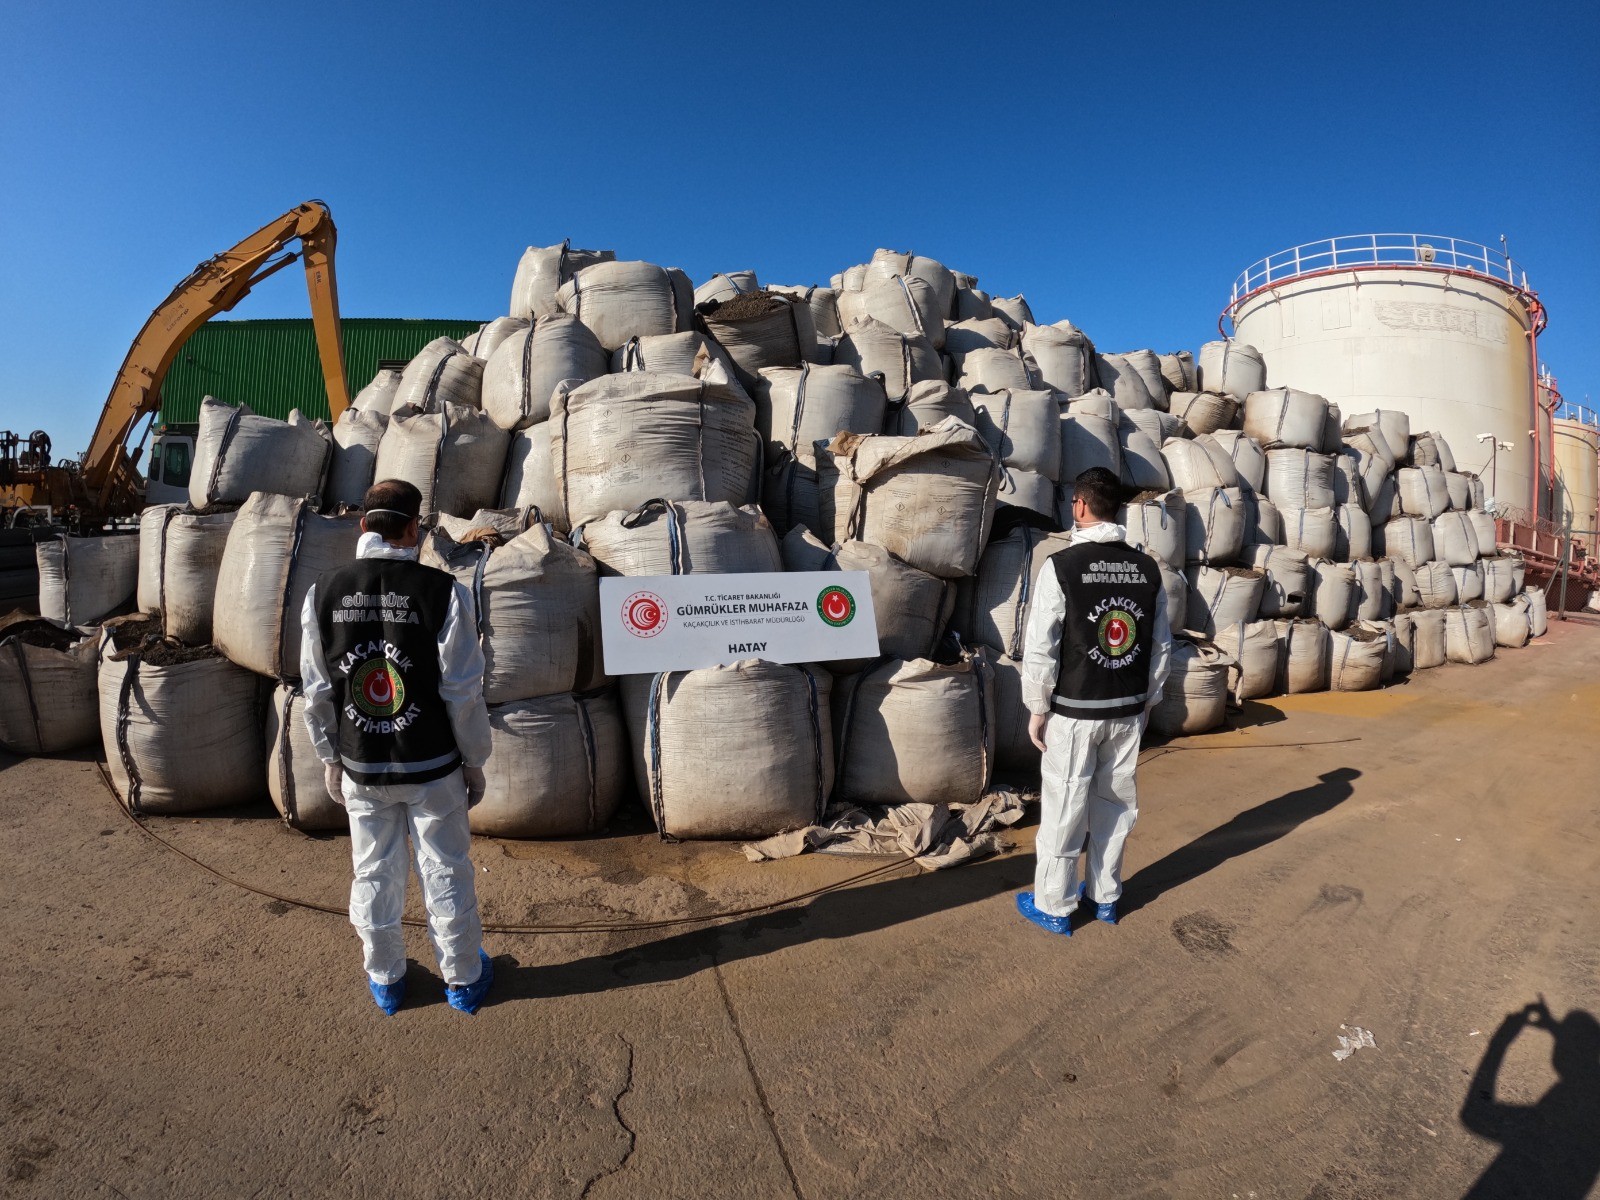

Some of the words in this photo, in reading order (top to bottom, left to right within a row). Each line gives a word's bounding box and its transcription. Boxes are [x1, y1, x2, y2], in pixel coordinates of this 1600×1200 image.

[1089, 560, 1139, 573] GÜMRÜK
[1081, 573, 1148, 584] MUHAFAZA
[342, 592, 410, 608] GÜMRÜK
[745, 592, 781, 600] BAKANLIĞI
[676, 603, 746, 616] GÜMRÜKLER
[748, 601, 809, 613] MUHAFAZA
[1087, 596, 1145, 623] KAÇAKÇILIK
[332, 610, 420, 625] MUHAFAZA
[683, 620, 720, 629] KAÇAKÇILIK
[728, 642, 767, 654] HATAY
[339, 639, 414, 674] KAÇAKÇILIK
[1087, 643, 1143, 669] İSTİHBARAT
[344, 703, 422, 734] İSTİHBARAT
